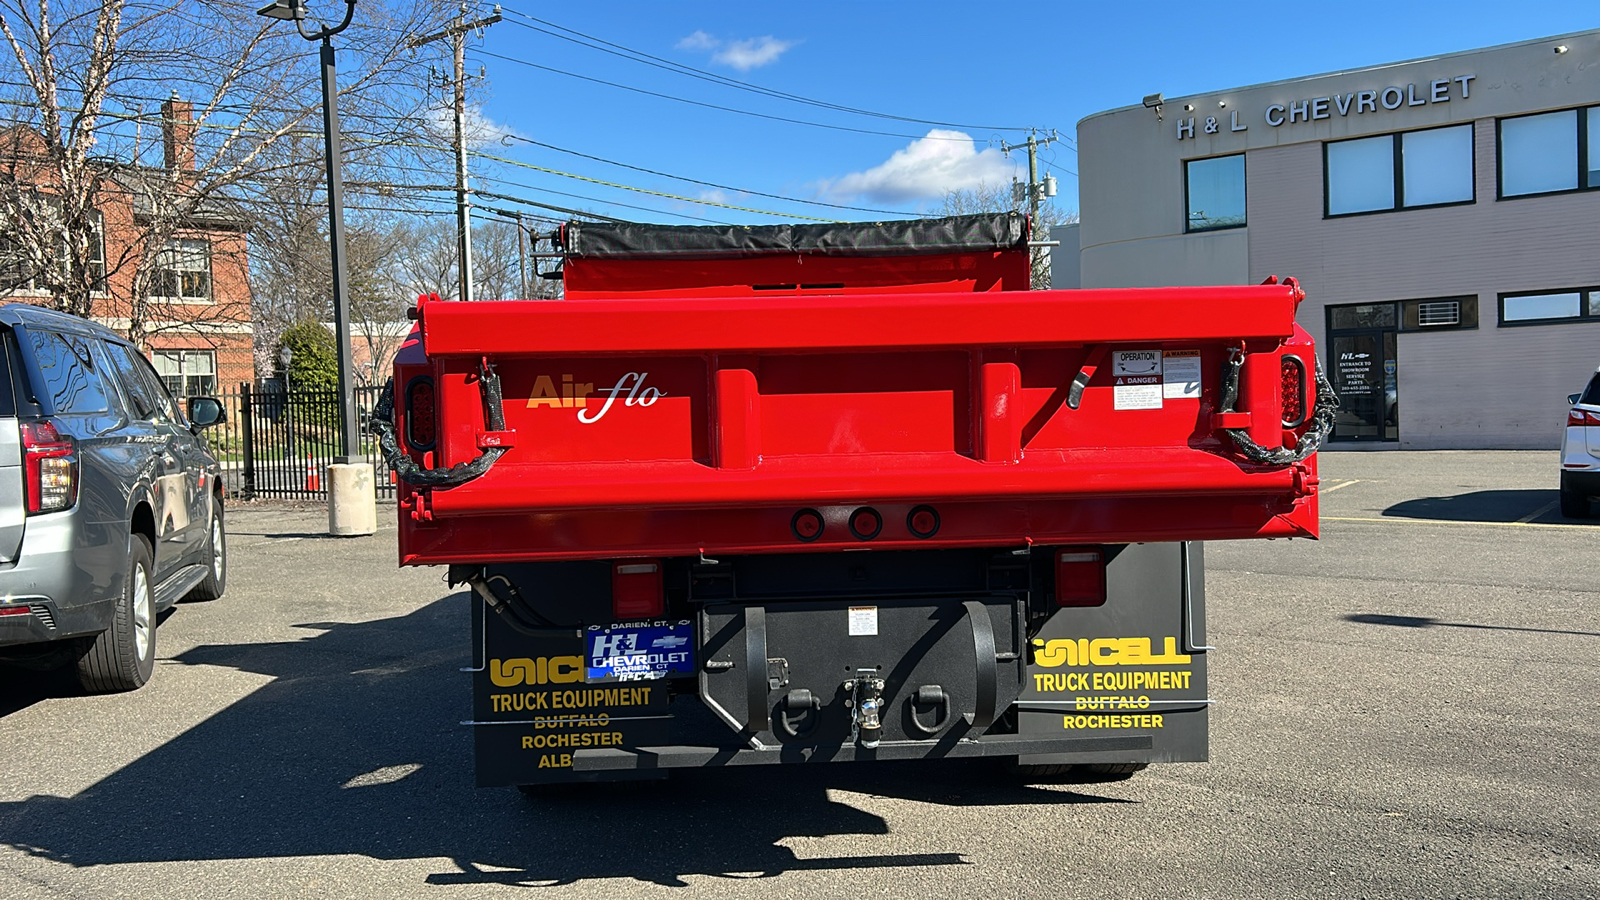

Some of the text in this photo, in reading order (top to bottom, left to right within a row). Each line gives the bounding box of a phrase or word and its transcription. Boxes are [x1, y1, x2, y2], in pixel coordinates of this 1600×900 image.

[1176, 74, 1477, 140] H & L CHEVROLET
[1120, 352, 1155, 361] OPERATION
[526, 372, 668, 424] Air flo
[611, 621, 651, 630] DARIEN,
[592, 633, 648, 658] H&L
[1032, 636, 1192, 667] UNICELL
[592, 652, 689, 668] CHEVROLET
[489, 655, 585, 687] UNIC
[1033, 671, 1192, 692] TRUCK EQUIPMENT
[490, 687, 652, 712] TRUCK EQUIPMENT
[1075, 695, 1150, 710] BUFFALO
[534, 712, 610, 729] BUFFALO
[1063, 714, 1164, 729] ROCHESTER
[522, 732, 623, 749] ROCHESTER
[538, 753, 574, 769] ALB
